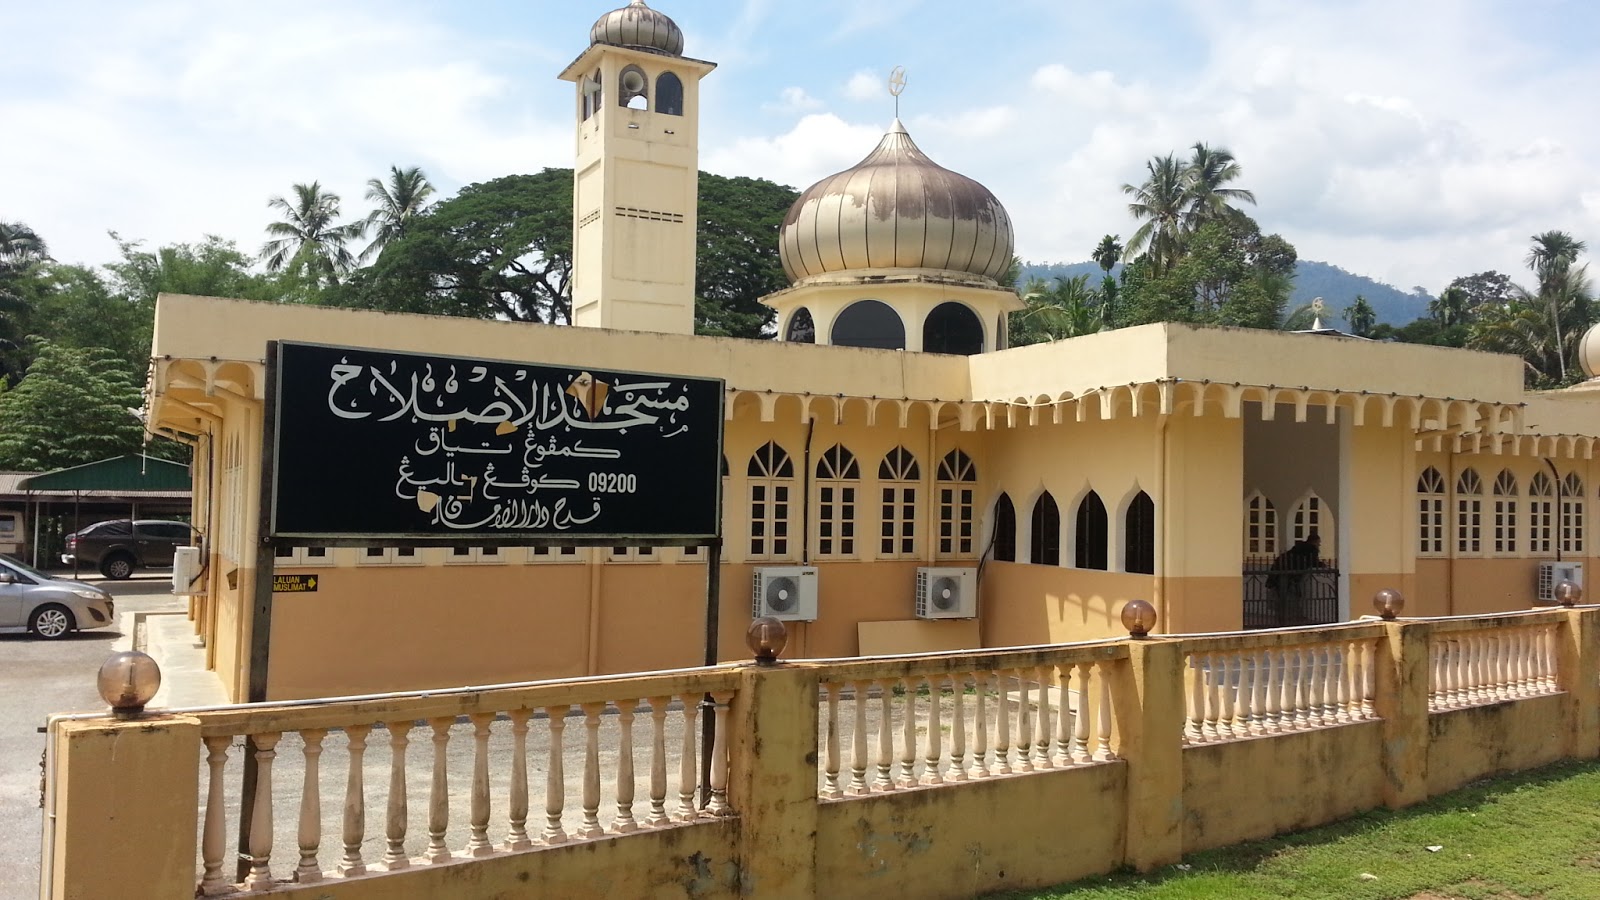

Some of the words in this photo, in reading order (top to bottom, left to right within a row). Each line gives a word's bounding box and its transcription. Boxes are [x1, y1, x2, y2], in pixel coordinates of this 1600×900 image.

[396, 456, 470, 499] اليڠ
[588, 472, 637, 493] 09200
[273, 576, 300, 584] LALUAN
[273, 583, 307, 591] MUSLIMAT
